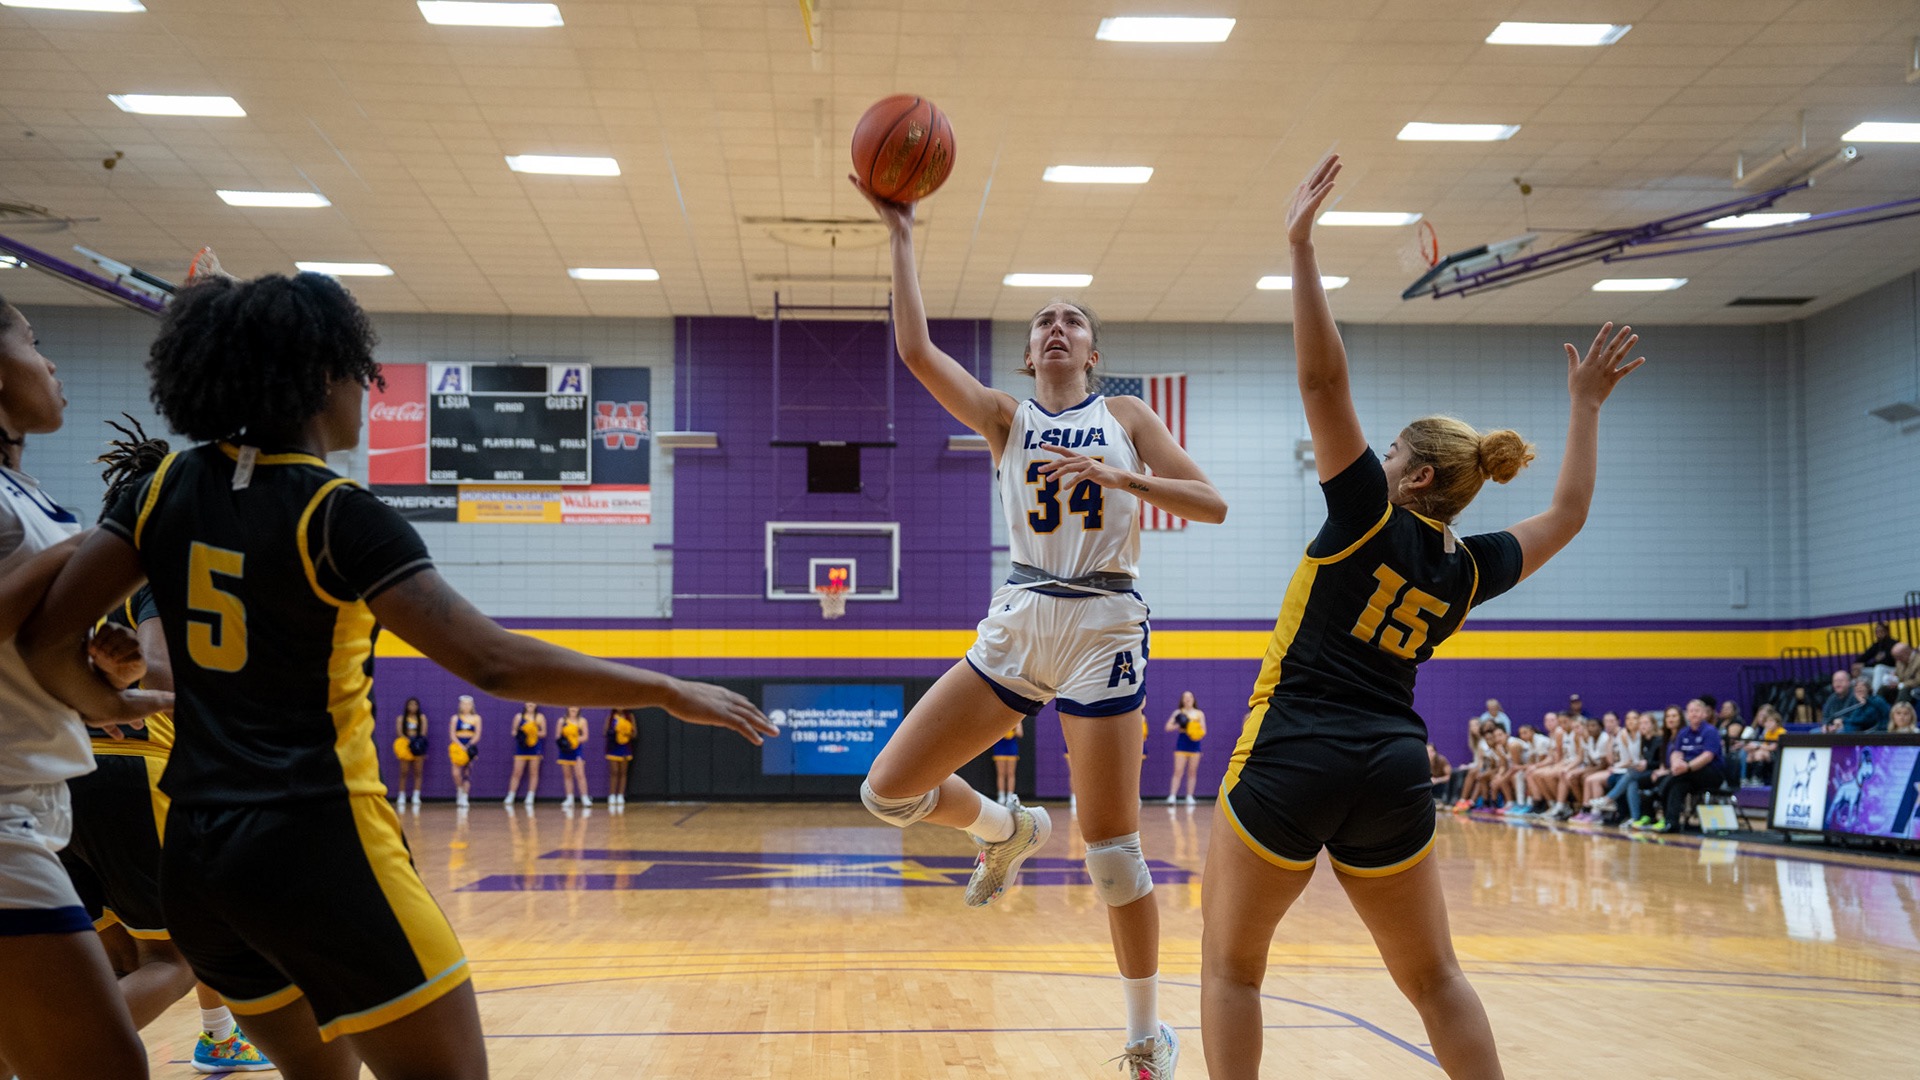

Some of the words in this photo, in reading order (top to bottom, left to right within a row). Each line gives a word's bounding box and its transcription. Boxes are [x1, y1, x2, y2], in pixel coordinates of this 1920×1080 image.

[438, 396, 470, 409] LSUA
[494, 402, 525, 413] PERIOD
[545, 396, 585, 410] GUEST
[431, 437, 458, 448] FOULS
[482, 437, 514, 448] PLAYER
[515, 437, 536, 448] FOUL
[559, 438, 587, 449] FOULS
[1023, 427, 1107, 450] LSUA
[431, 470, 458, 480] SCORE
[494, 470, 524, 480] MATCH
[559, 471, 586, 480] SCORE
[1025, 456, 1105, 535] 34
[375, 496, 457, 508] OWERADE
[187, 541, 248, 673] 5
[1351, 563, 1450, 660] 15
[879, 709, 898, 719] and
[787, 718, 818, 729] Sports
[819, 718, 861, 728] Medicine
[791, 731, 818, 743] (318)
[819, 731, 874, 743] 443-7622
[1786, 804, 1811, 818] LSUA
